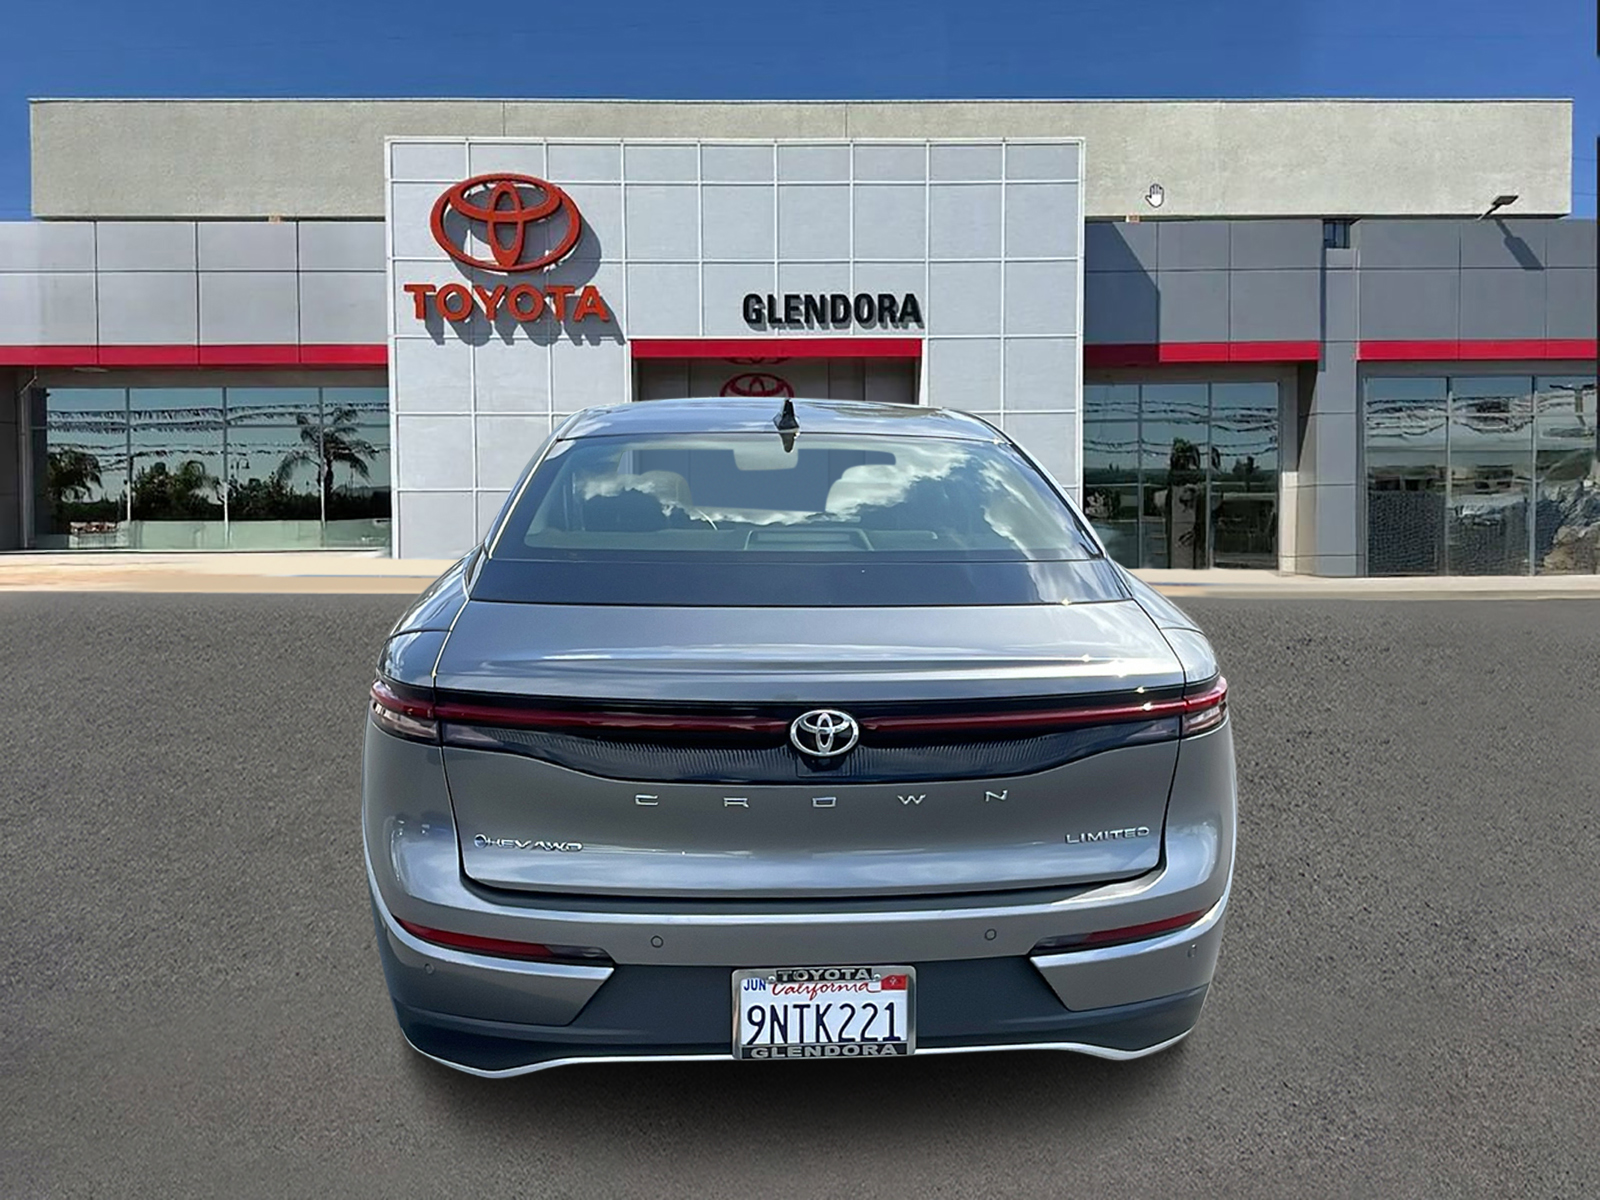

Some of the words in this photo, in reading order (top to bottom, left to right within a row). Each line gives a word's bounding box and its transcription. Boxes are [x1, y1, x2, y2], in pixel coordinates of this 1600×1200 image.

[404, 284, 611, 323] TOYOTA
[743, 293, 922, 326] GLENDORA
[635, 789, 1008, 807] CROWN
[1066, 826, 1150, 844] LIMITED
[532, 840, 583, 851] AWD
[777, 968, 872, 982] TOYOTA
[743, 979, 766, 991] JUN
[771, 981, 881, 1001] California
[746, 1002, 902, 1046] 9NTK221
[750, 1044, 898, 1059] GLENDORA
